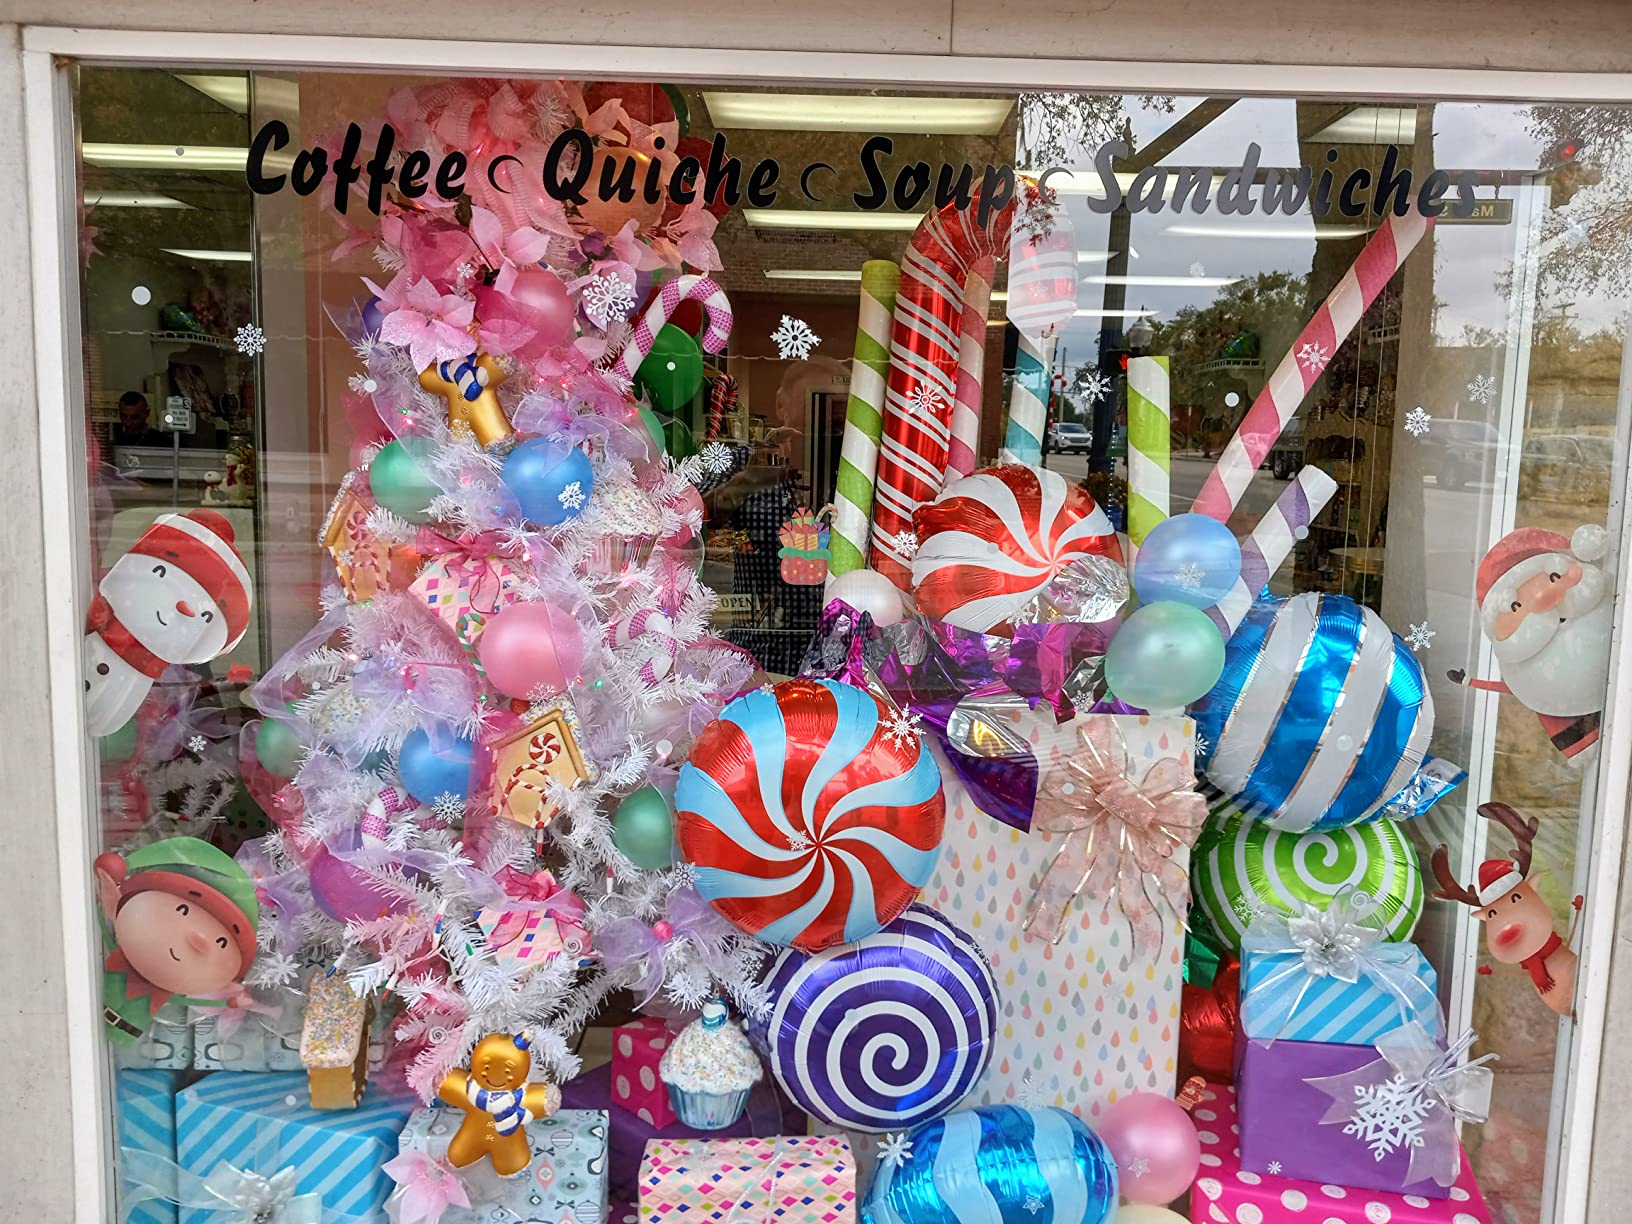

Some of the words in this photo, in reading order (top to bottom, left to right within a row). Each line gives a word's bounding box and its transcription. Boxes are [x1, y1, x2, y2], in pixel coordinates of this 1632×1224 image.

[246, 119, 466, 215] Coffee
[543, 127, 780, 208] Quiche
[853, 135, 1014, 227] Soup
[1087, 141, 1480, 218] Sandwiches
[721, 597, 752, 608] OPEN
